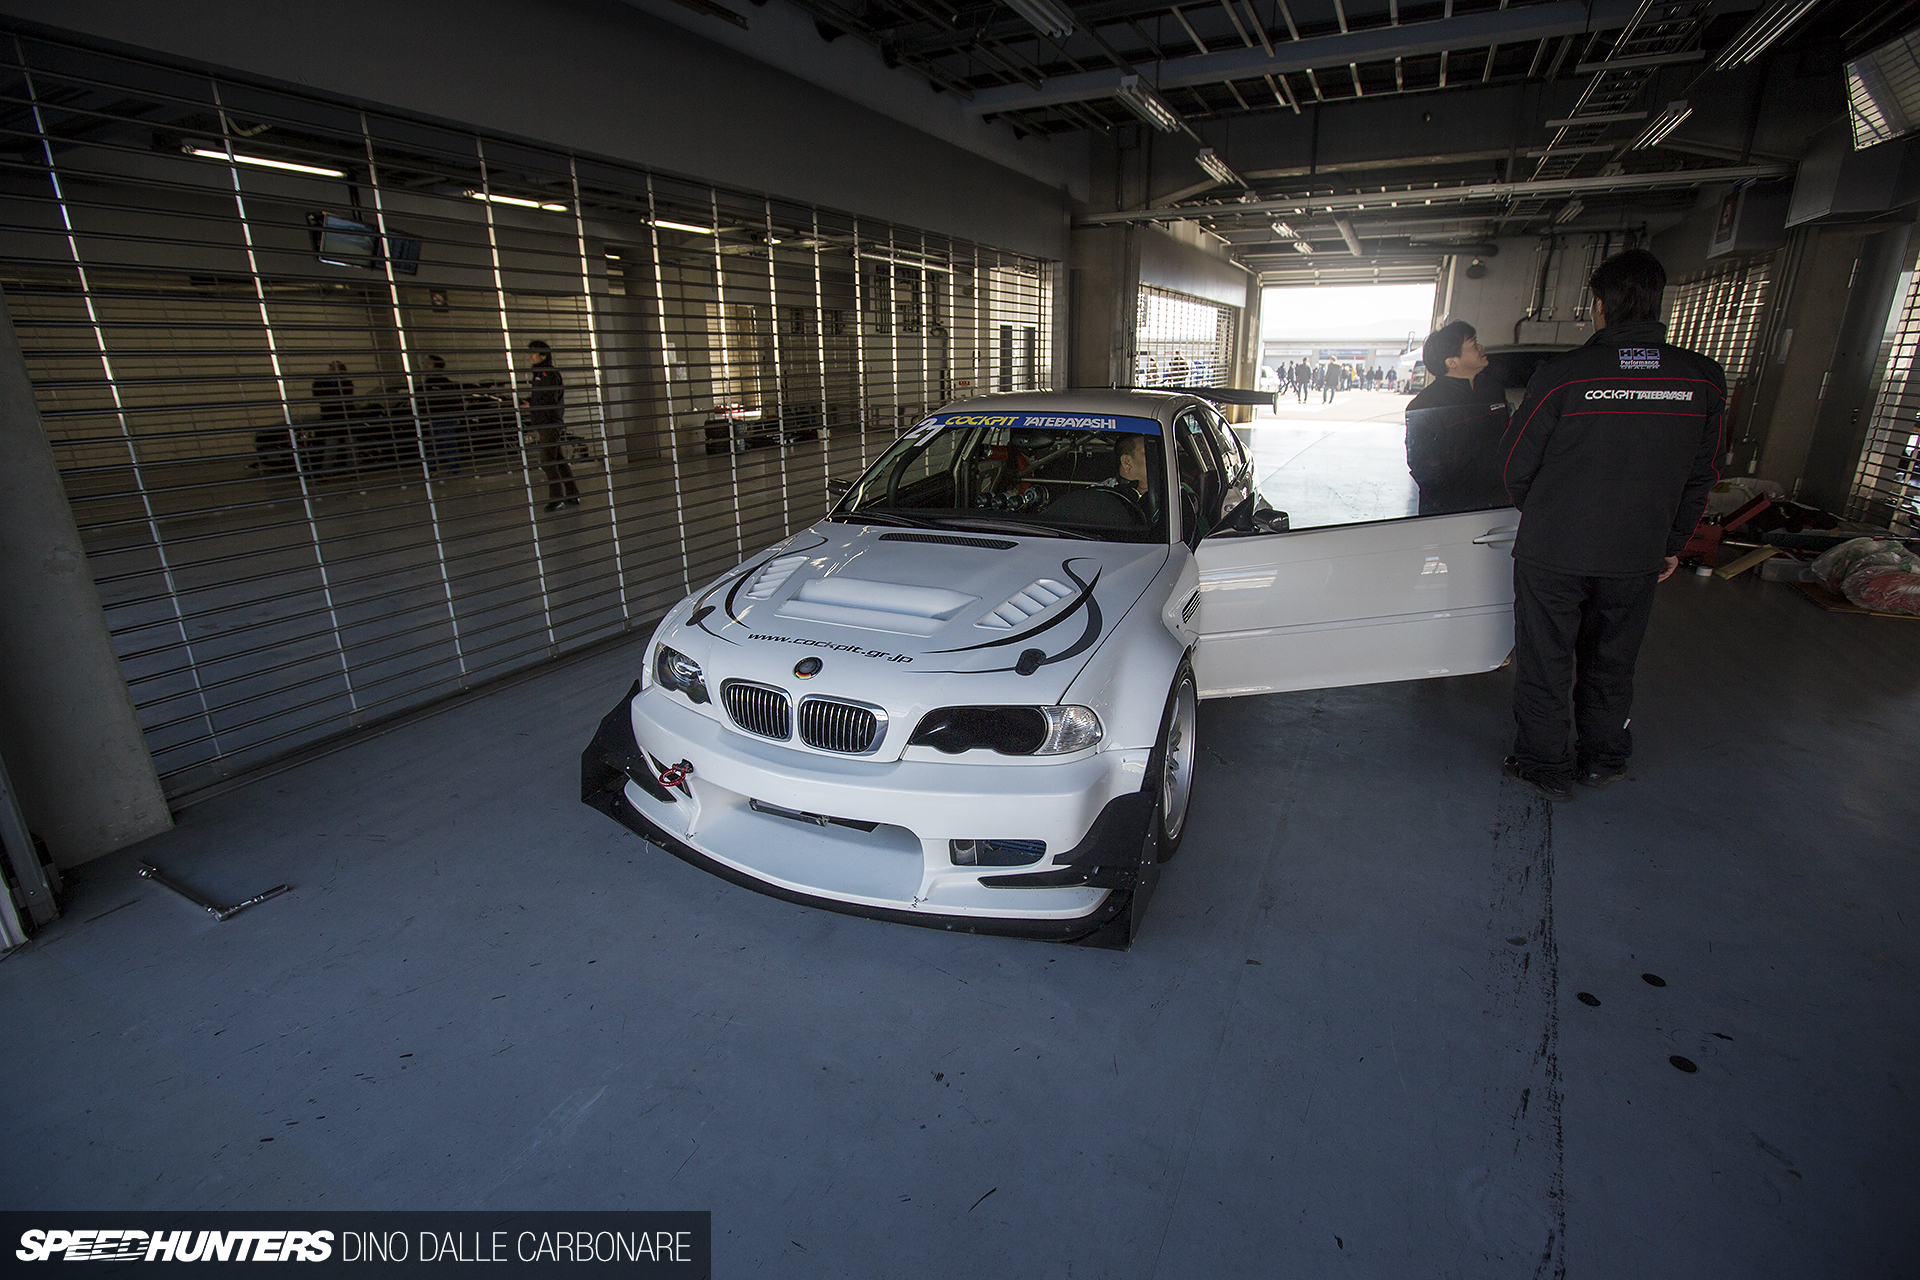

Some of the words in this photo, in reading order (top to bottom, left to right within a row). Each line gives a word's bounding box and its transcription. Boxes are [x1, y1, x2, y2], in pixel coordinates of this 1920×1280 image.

[1619, 348, 1660, 360] HKS
[1584, 389, 1637, 400] COCKPIT
[1636, 390, 1694, 401] TATEBAYASHI
[945, 415, 1019, 426] COCKPIT
[1022, 416, 1117, 429] TATEBAYASHI
